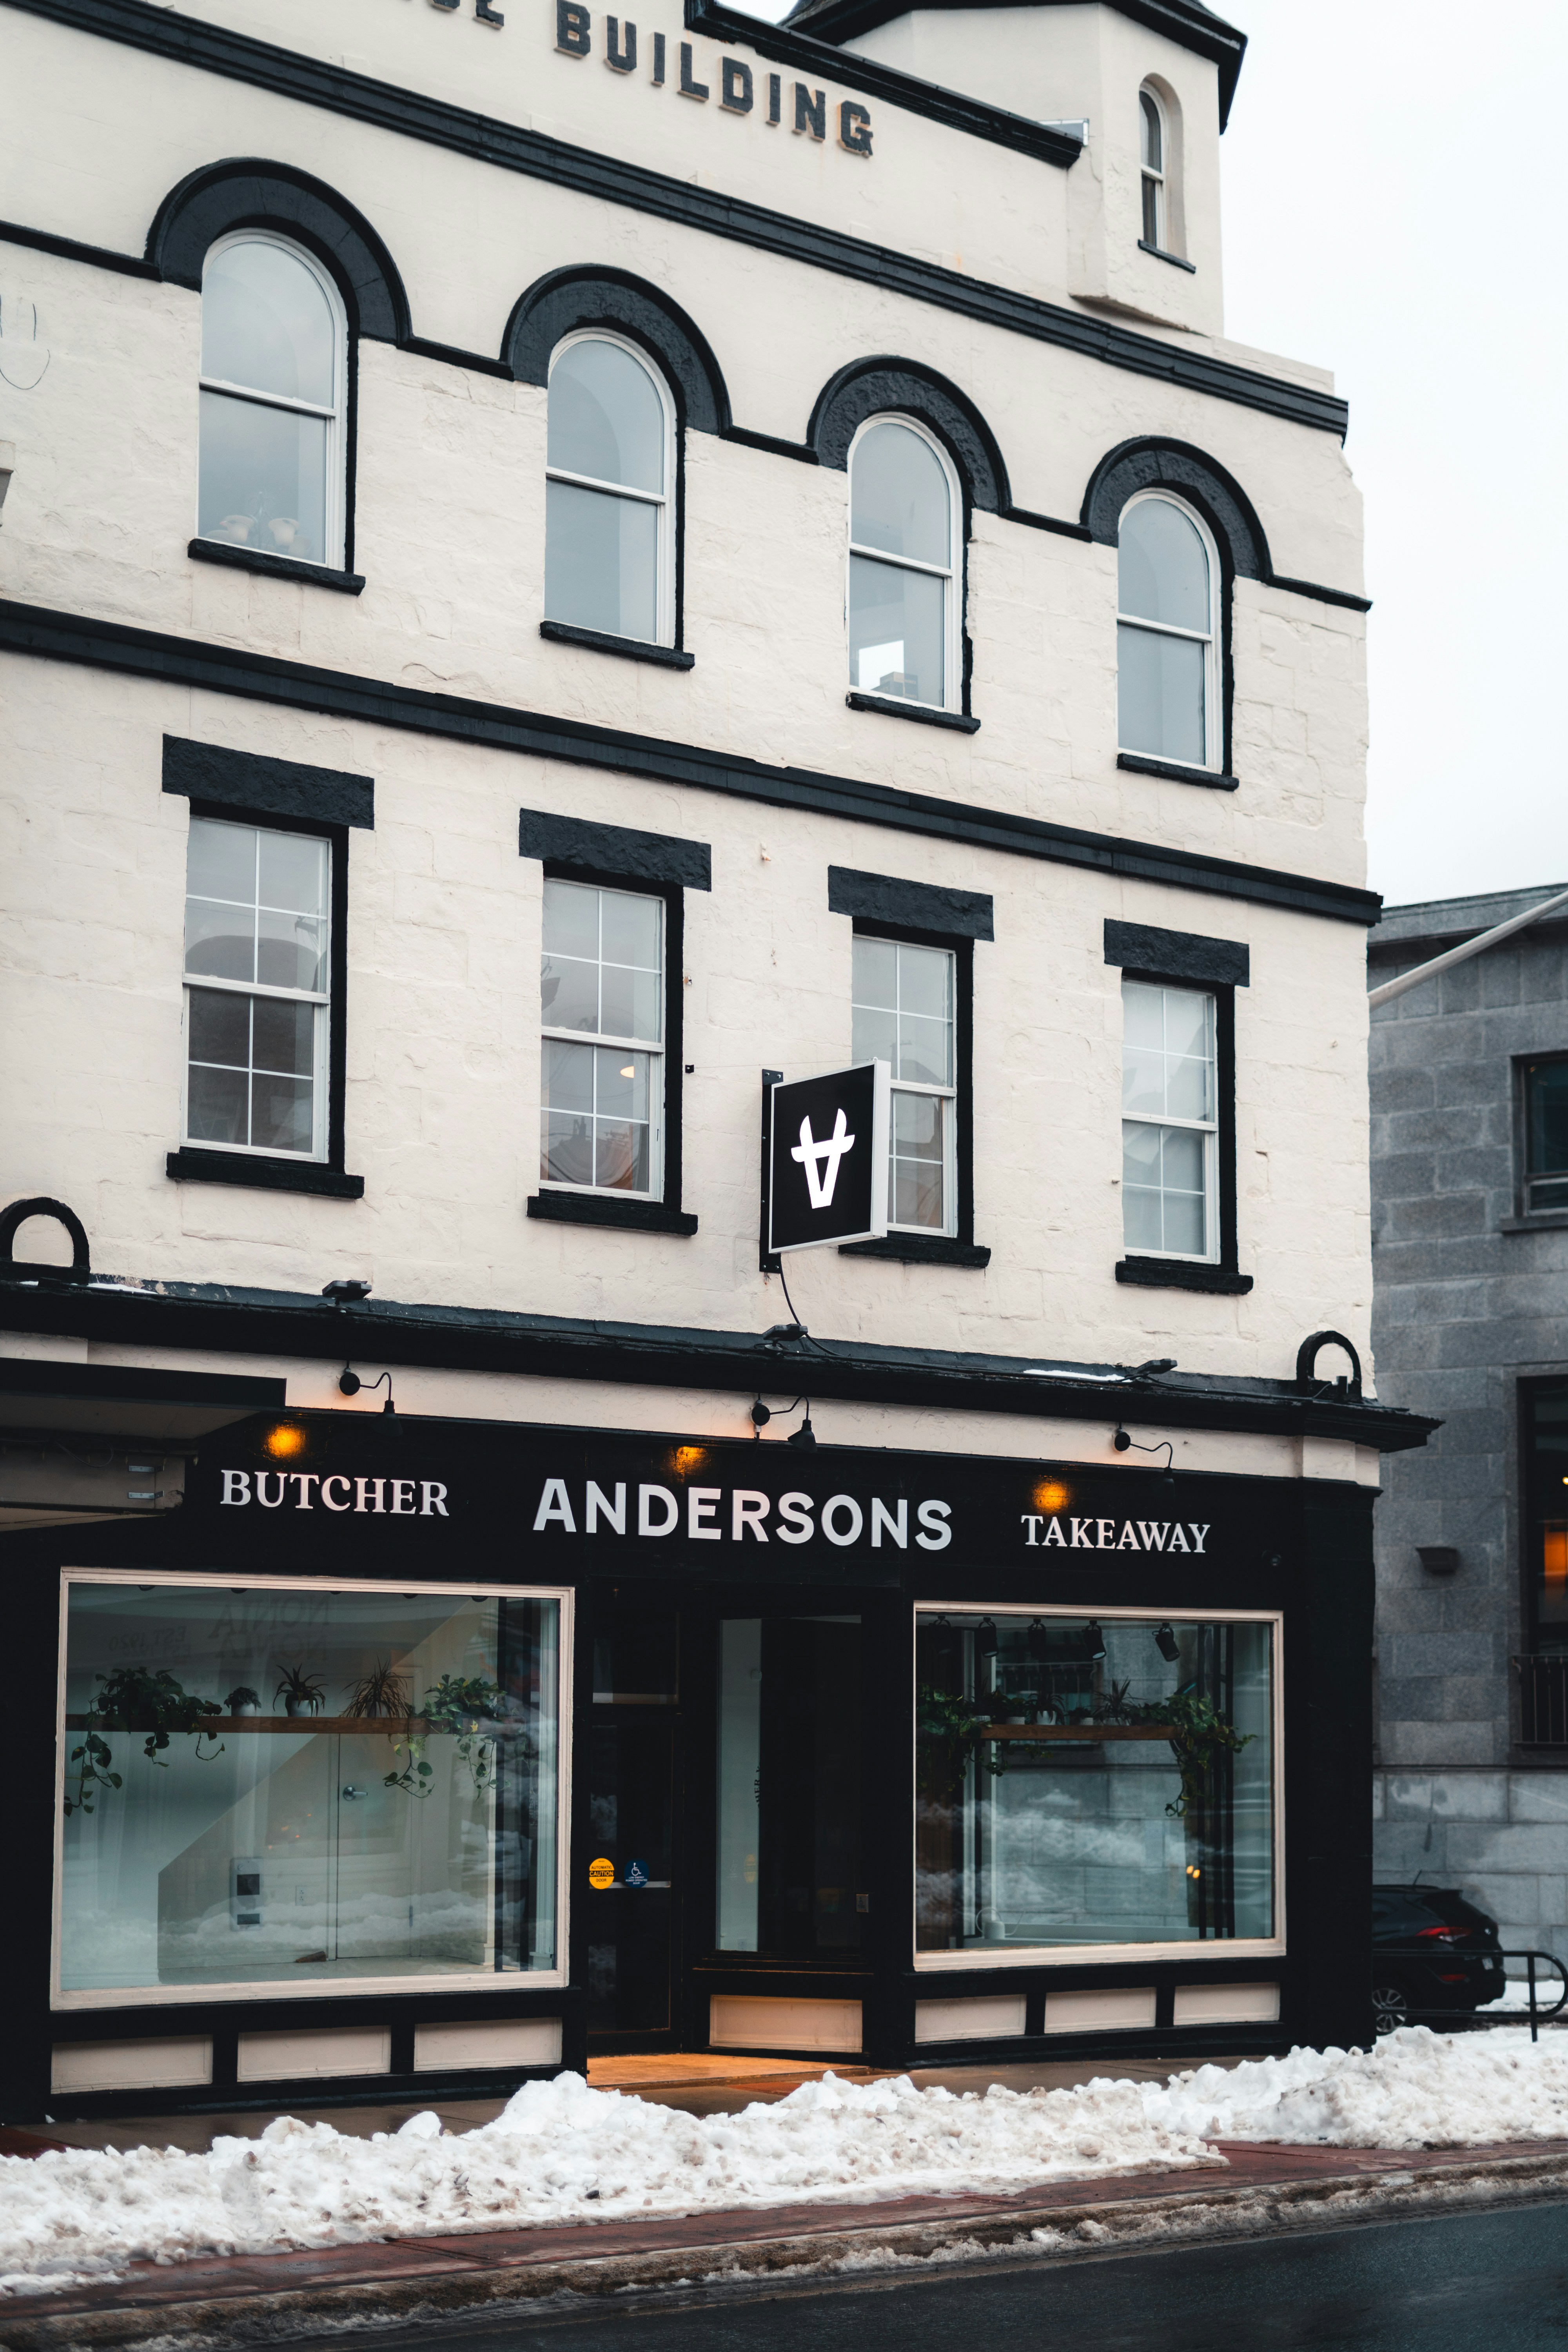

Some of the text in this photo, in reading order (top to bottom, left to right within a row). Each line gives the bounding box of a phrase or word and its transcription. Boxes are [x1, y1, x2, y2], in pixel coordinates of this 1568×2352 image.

[554, 0, 873, 158] BUILDING
[220, 1470, 449, 1516] BUTCHER
[533, 1478, 952, 1550] ANDERSONS
[1021, 1515, 1210, 1553] TAKEAWAY
